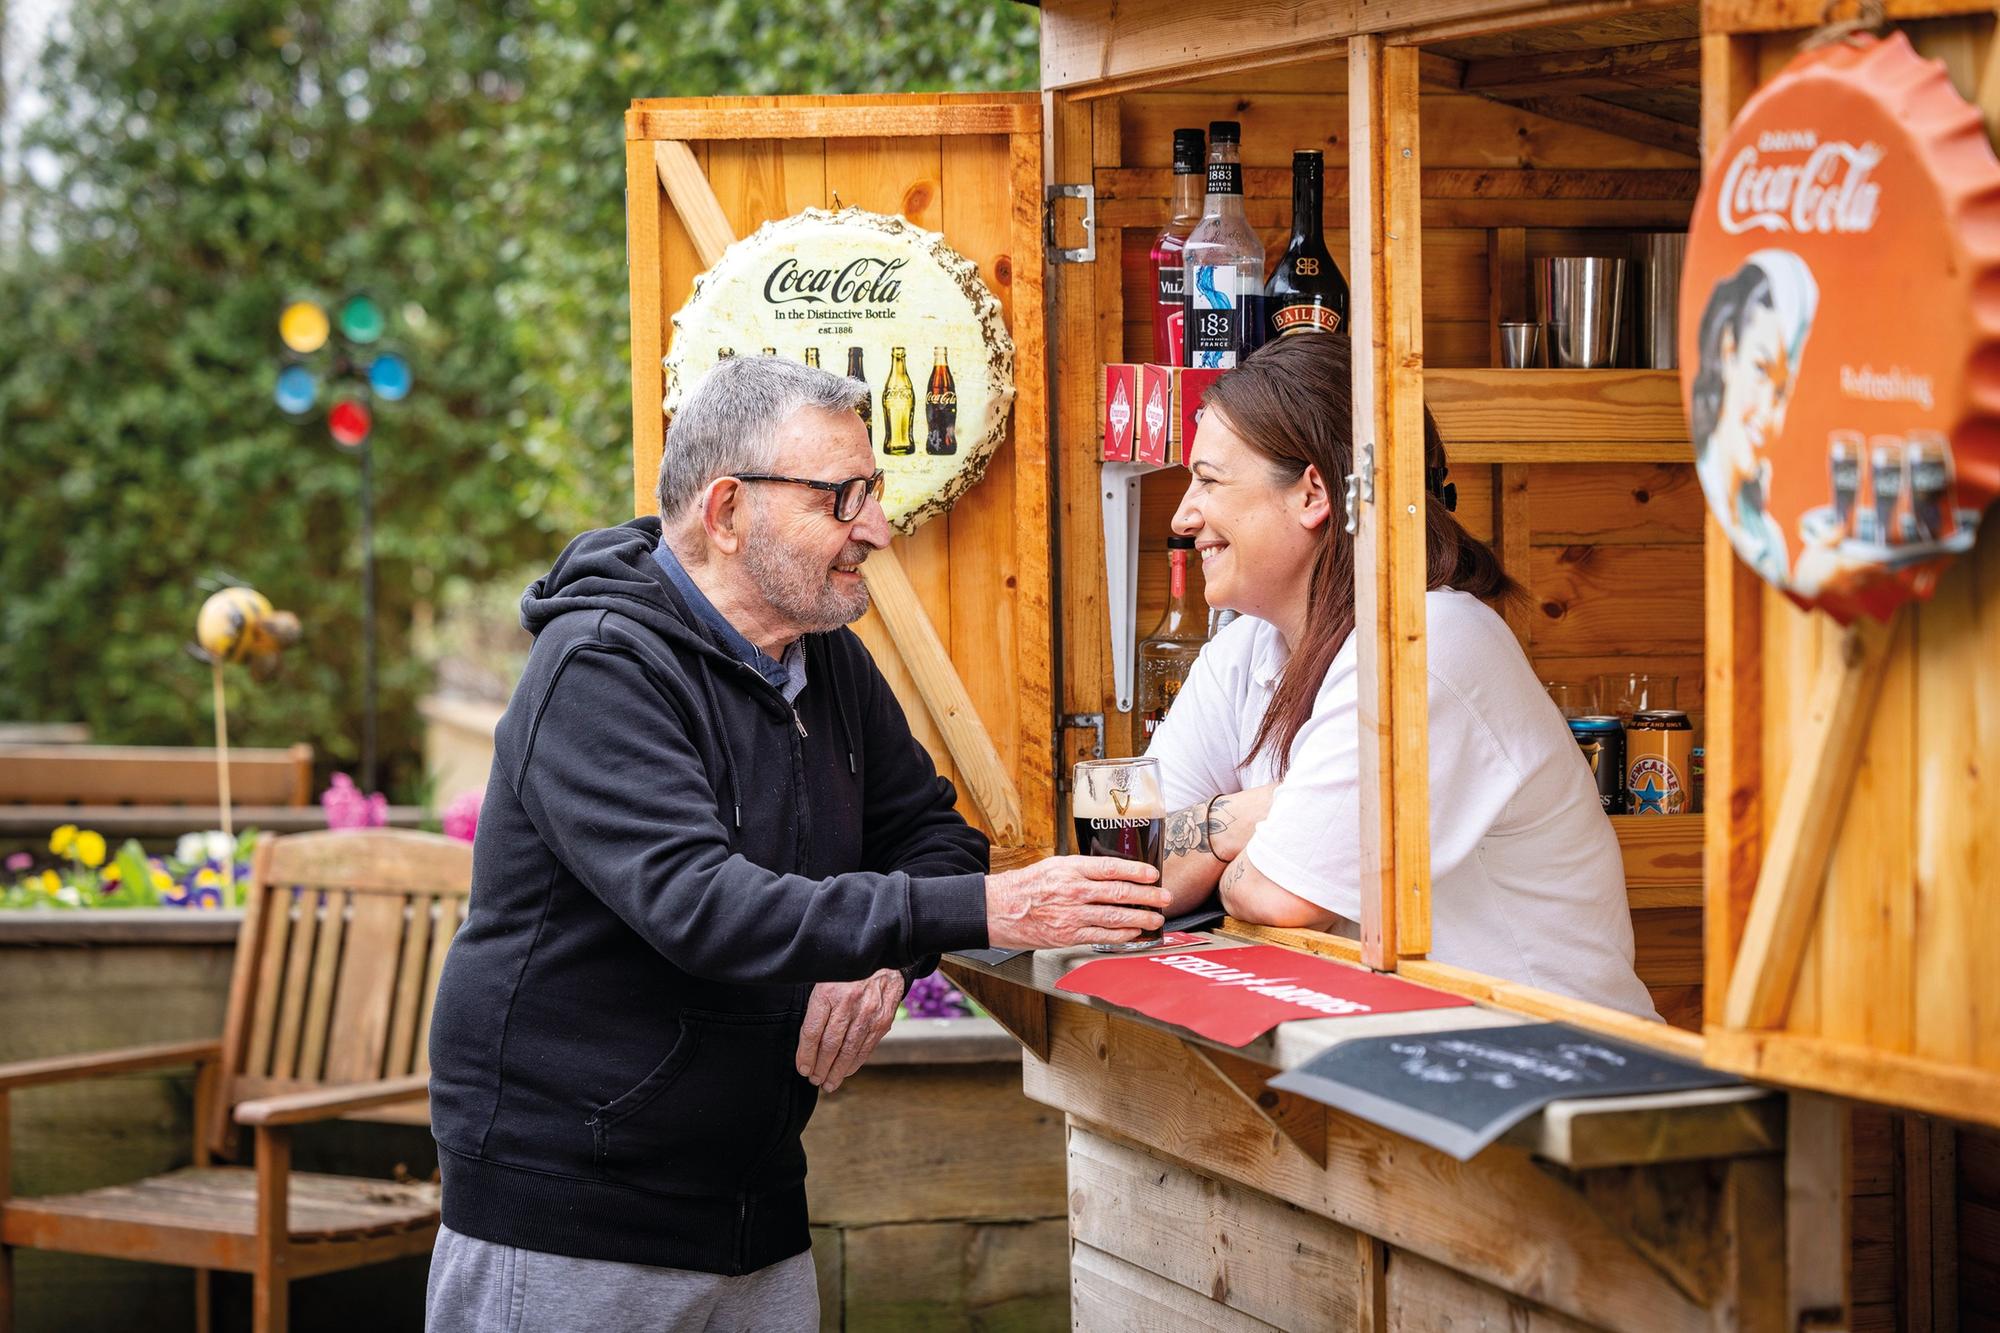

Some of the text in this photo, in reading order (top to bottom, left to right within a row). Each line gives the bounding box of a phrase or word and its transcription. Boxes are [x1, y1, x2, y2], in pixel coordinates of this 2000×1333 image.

[1209, 170, 1232, 181] 1883
[763, 257, 910, 304] Coca-Cola
[775, 308, 896, 320] In the Distinctive Bottle
[1090, 816, 1151, 830] GUINNESS
